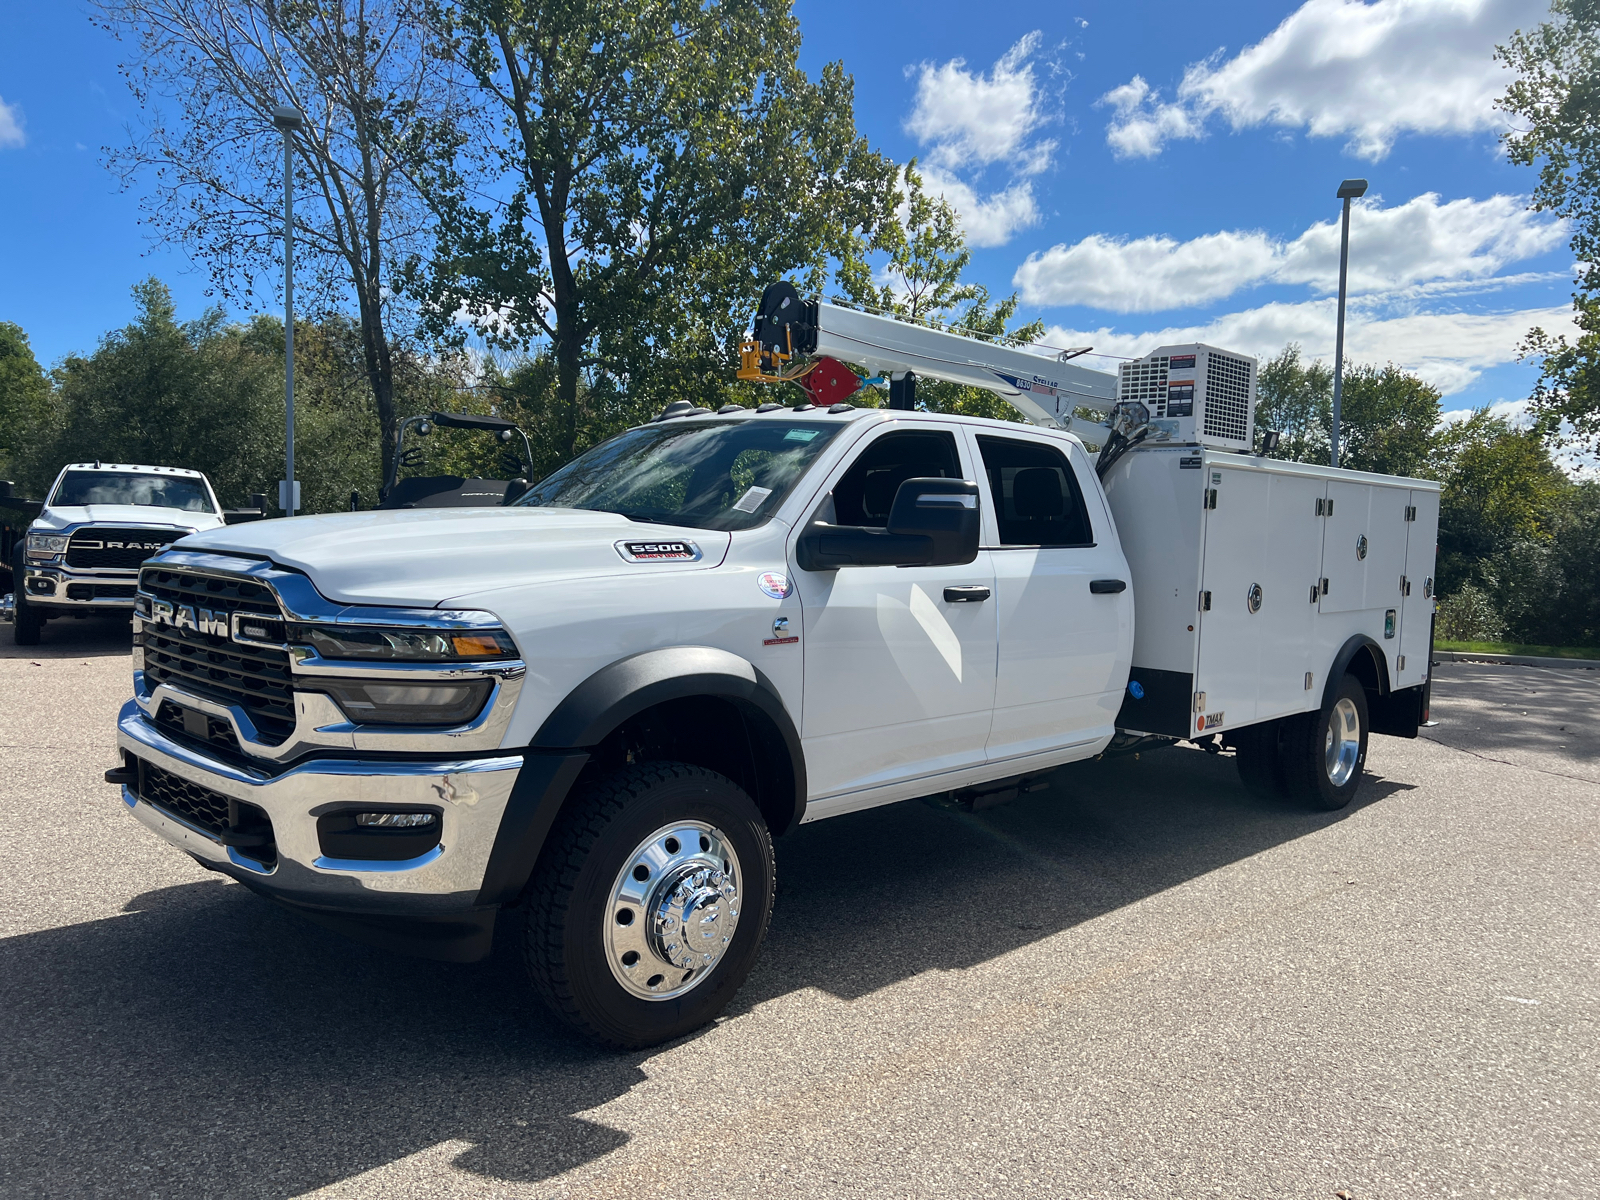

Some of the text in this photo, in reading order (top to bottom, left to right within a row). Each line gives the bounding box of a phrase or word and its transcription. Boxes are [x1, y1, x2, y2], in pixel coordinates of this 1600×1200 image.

[1016, 379, 1030, 389] 8630
[106, 541, 162, 549] RAM
[631, 544, 684, 552] 5500
[153, 599, 229, 638] RAM
[1206, 712, 1223, 725] TMAX
